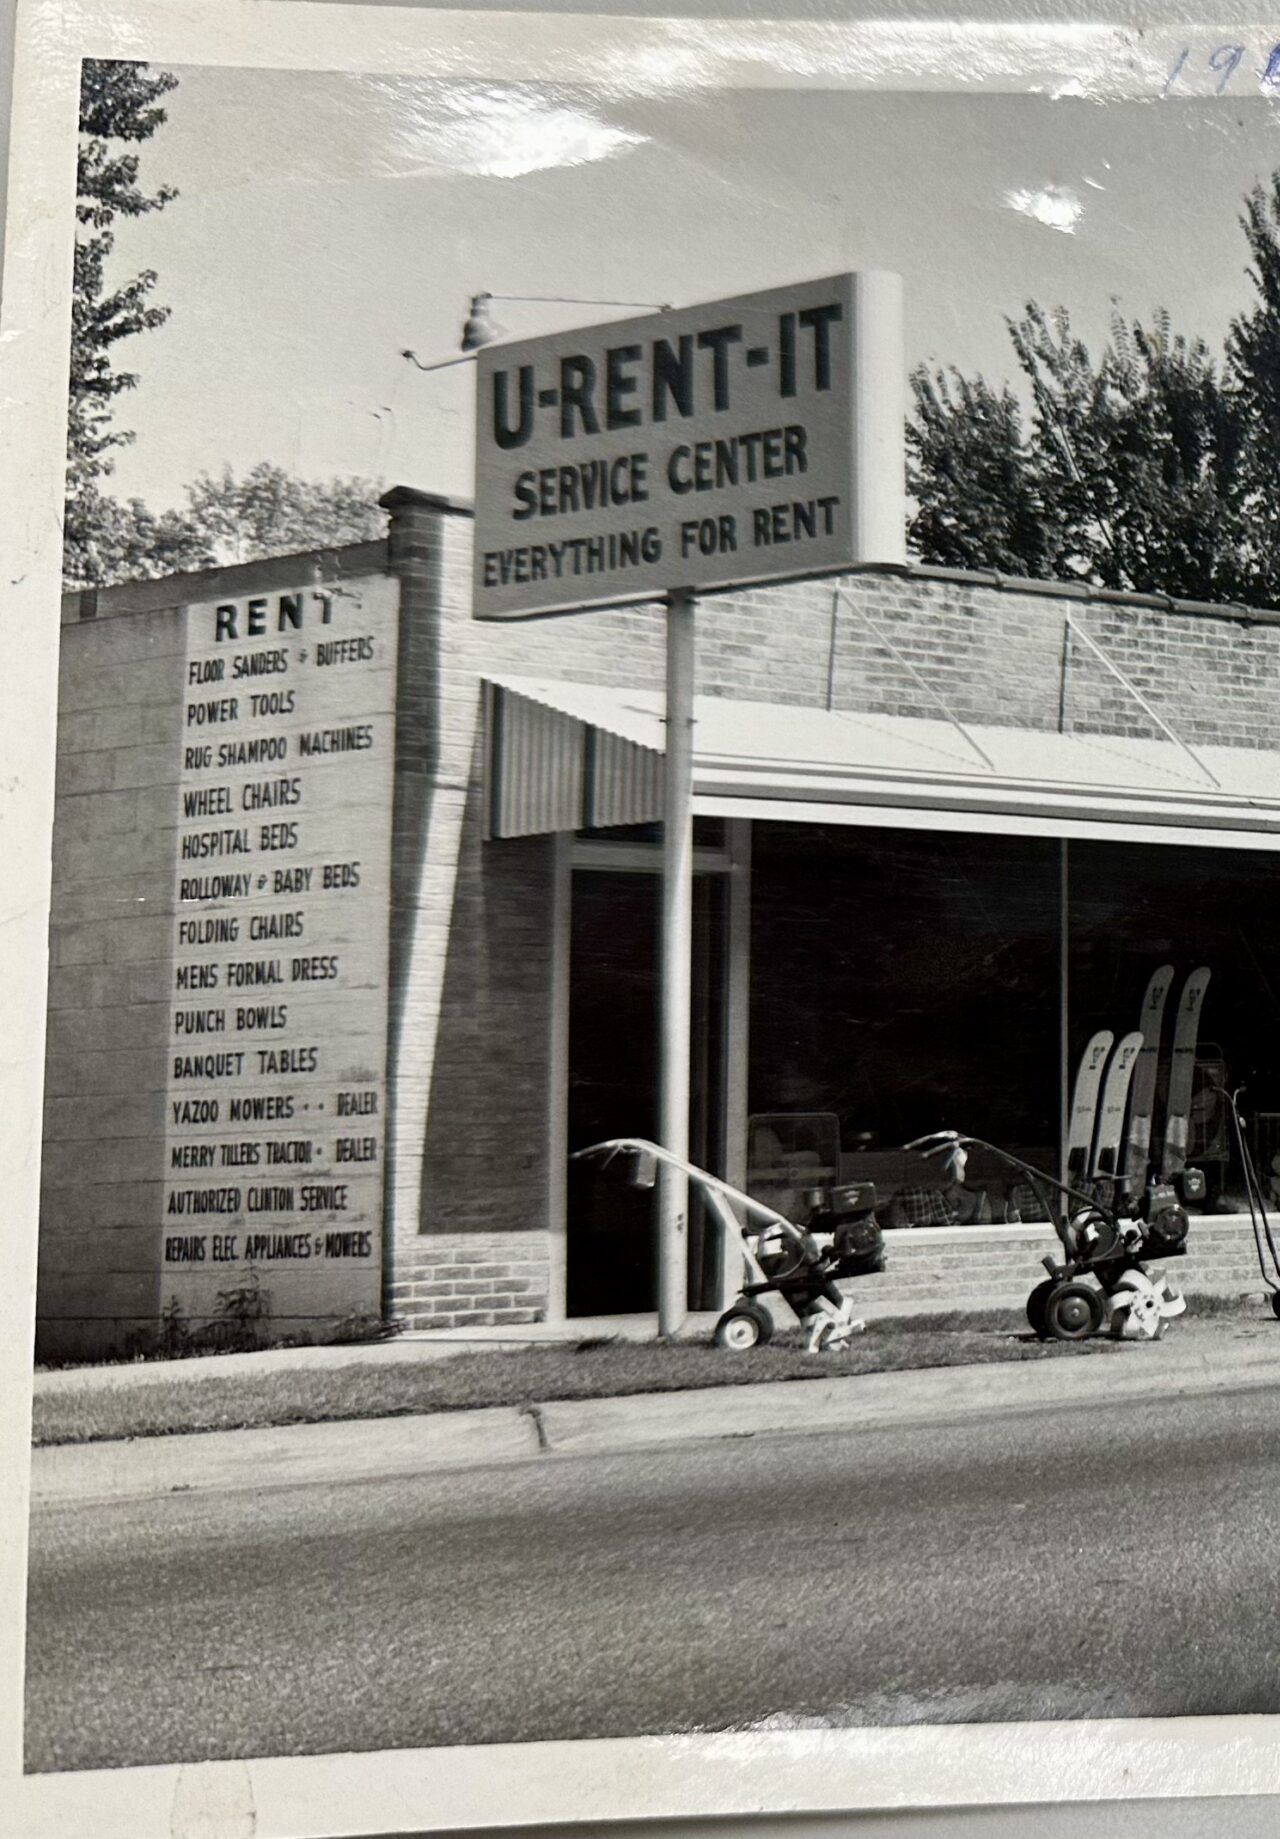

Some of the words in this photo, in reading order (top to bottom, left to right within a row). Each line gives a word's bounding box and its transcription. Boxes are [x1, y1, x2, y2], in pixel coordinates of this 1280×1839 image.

[493, 303, 843, 450] U-RENT-IT
[512, 452, 649, 521] SERVICE
[668, 424, 808, 496] CENTER
[483, 526, 661, 588] EVERYTHING
[681, 513, 737, 559] FOR
[753, 496, 840, 547] RENT
[216, 593, 332, 641] RENT
[189, 659, 223, 685] FLOOR
[232, 649, 288, 678] SANDERS
[317, 636, 374, 666] BUFFERS
[188, 698, 238, 726] POWER
[251, 691, 294, 716] TOOLS
[185, 746, 211, 768] RUG
[218, 737, 287, 766] SHAMPOO
[300, 725, 373, 755] MACHINES
[184, 787, 233, 817] WHEEL
[243, 778, 301, 810] CHAIRS
[182, 828, 250, 859] HOSPITAL
[261, 823, 298, 850] BEDS
[181, 873, 251, 900] ROLLOWAY
[274, 867, 312, 893] BABY
[323, 862, 360, 889] BEDS
[179, 918, 239, 944] FOLDING
[250, 912, 303, 940] CHAIRS
[177, 964, 218, 989] MENS
[227, 960, 283, 987] FORMAL
[292, 956, 338, 981] DRESS
[175, 1009, 225, 1034] PUNCH
[237, 1005, 287, 1030] BOWLS
[174, 1053, 244, 1079] BANQUET
[258, 1048, 318, 1073] TABLES
[173, 1100, 218, 1123] YAZOO
[230, 1097, 294, 1121] MOWERS
[337, 1092, 378, 1116] DEALER
[172, 1146, 216, 1168] MERRY
[220, 1143, 260, 1165] TILLERS
[267, 1141, 312, 1164] TRACTOR
[336, 1138, 377, 1162] DEALER
[168, 1188, 241, 1214] AUTHORIZED
[248, 1187, 294, 1211] CLINTON
[300, 1185, 348, 1210] SERVICE
[165, 1236, 206, 1262] REPAIRS
[244, 1233, 311, 1260] APPLIANCES
[325, 1231, 372, 1257] MOWERS
